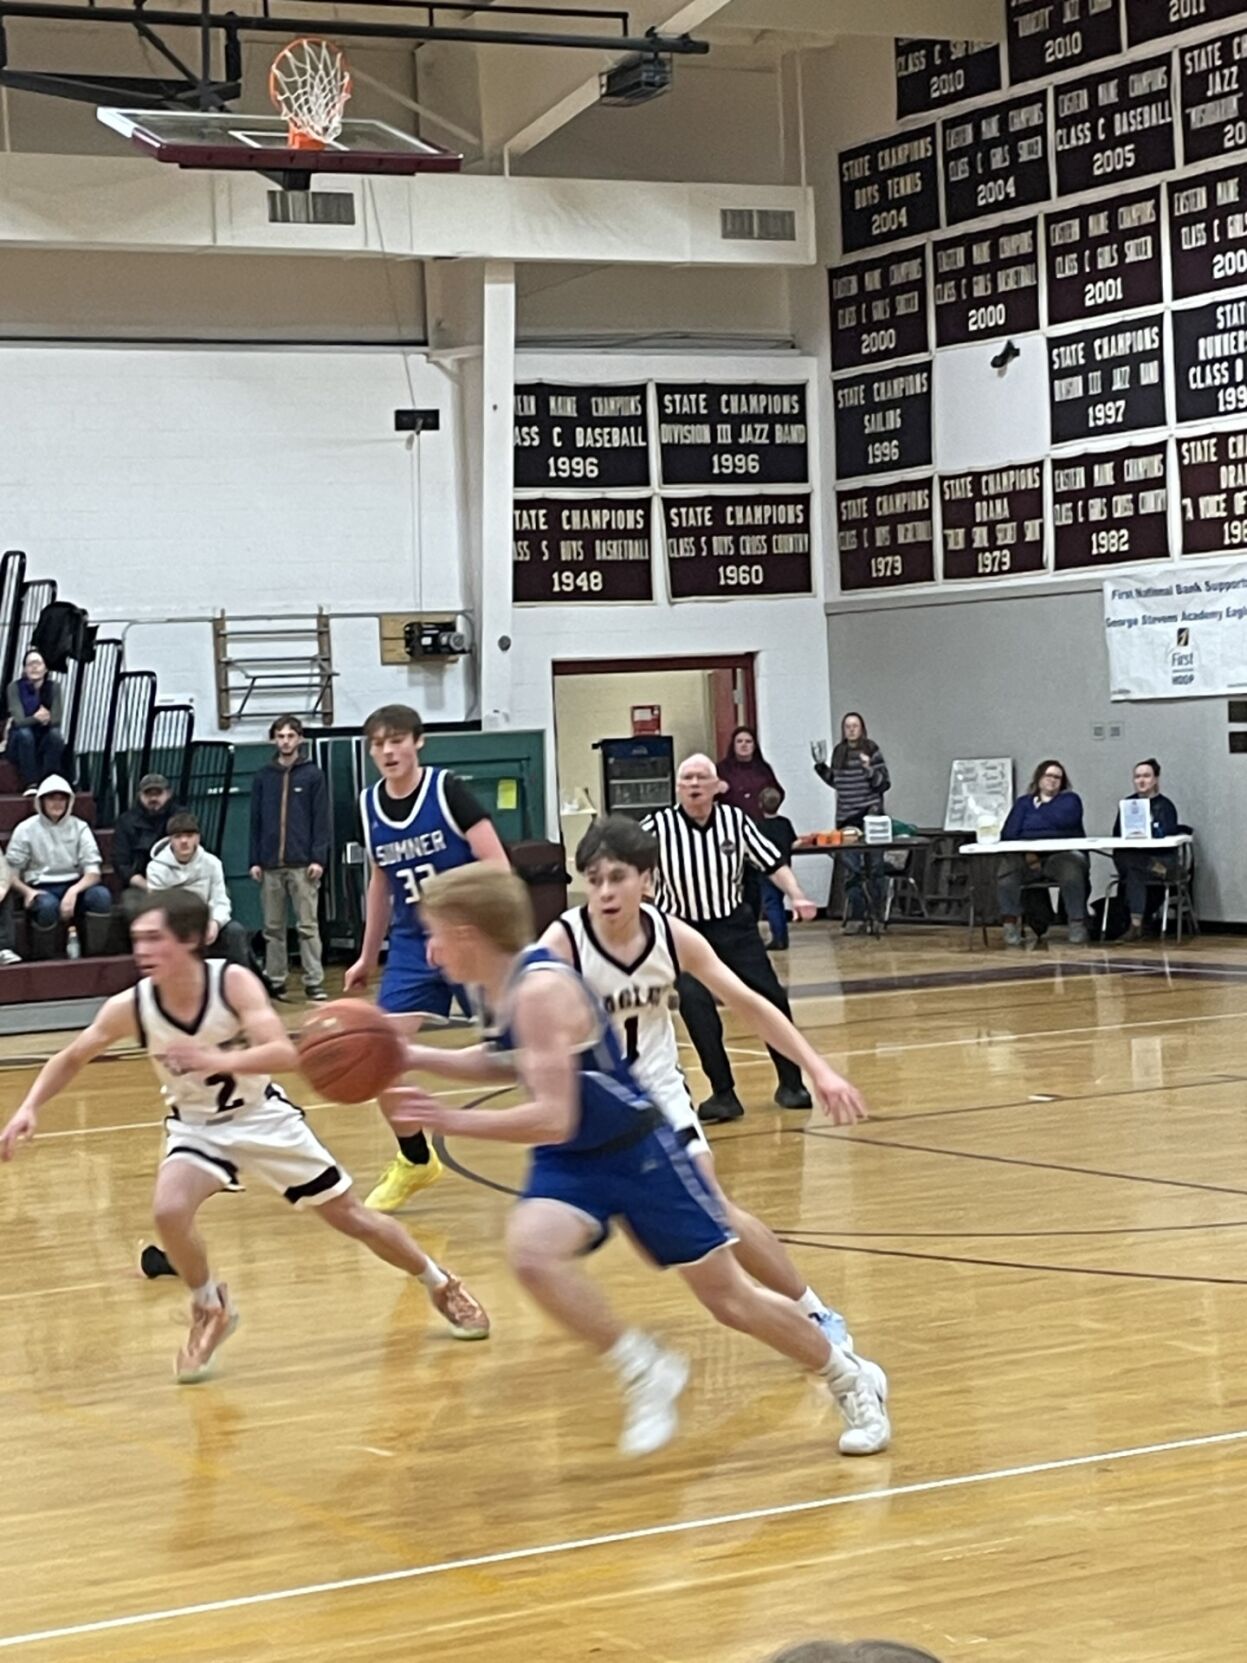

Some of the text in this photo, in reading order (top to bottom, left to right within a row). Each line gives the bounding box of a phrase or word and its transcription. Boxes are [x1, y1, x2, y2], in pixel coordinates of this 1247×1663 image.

[1044, 31, 1082, 62] 2010
[1185, 41, 1222, 75] STATE
[930, 69, 965, 98] 2010
[1206, 65, 1239, 97] JAZZ
[1056, 122, 1091, 151] CLASS
[1098, 117, 1105, 140] C
[1114, 100, 1171, 136] BASEBALL
[842, 155, 871, 182] STATE
[878, 136, 933, 171] CHAMPIONS
[1093, 144, 1135, 175] 2005
[977, 175, 1016, 206] 2004
[872, 206, 908, 235] 2004
[1213, 218, 1220, 243] C
[1084, 277, 1123, 307] 2001
[968, 303, 1006, 332] 2000
[1216, 301, 1247, 330] STAT
[861, 328, 896, 355] 2000
[1052, 325, 1160, 370] STATE CHAMPIONS
[1188, 361, 1229, 390] CLASS
[664, 394, 799, 415] STATE CHAMPIONS
[837, 372, 928, 409] STATE CHAMPIONS
[1088, 399, 1126, 428] 1997
[514, 426, 647, 448] ASS C BASEBALL
[660, 423, 806, 444] DIVISION III JAZZ BAND
[712, 454, 760, 474] 1996
[868, 439, 899, 464] 1996
[1181, 437, 1218, 466] STATE
[548, 456, 599, 478] 1996
[943, 466, 1040, 500] STATE CHAMPIONS
[669, 504, 804, 528] STATE CHAMPIONS
[840, 488, 929, 521] STATE CHAMPIONS
[514, 509, 645, 531] TATE CHAMPIONS
[541, 540, 549, 561] S
[595, 539, 649, 560] BASKETBALL
[668, 536, 696, 558] CLASS
[700, 536, 707, 557] S
[1091, 528, 1130, 556] 1982
[552, 570, 603, 592] 1948
[718, 565, 763, 586] 1960
[1112, 589, 1134, 600] First
[1176, 582, 1203, 595] Bank
[1171, 652, 1194, 667] First
[375, 829, 447, 867] SUMNER
[624, 1015, 640, 1062] 1
[205, 1070, 245, 1114] 2
